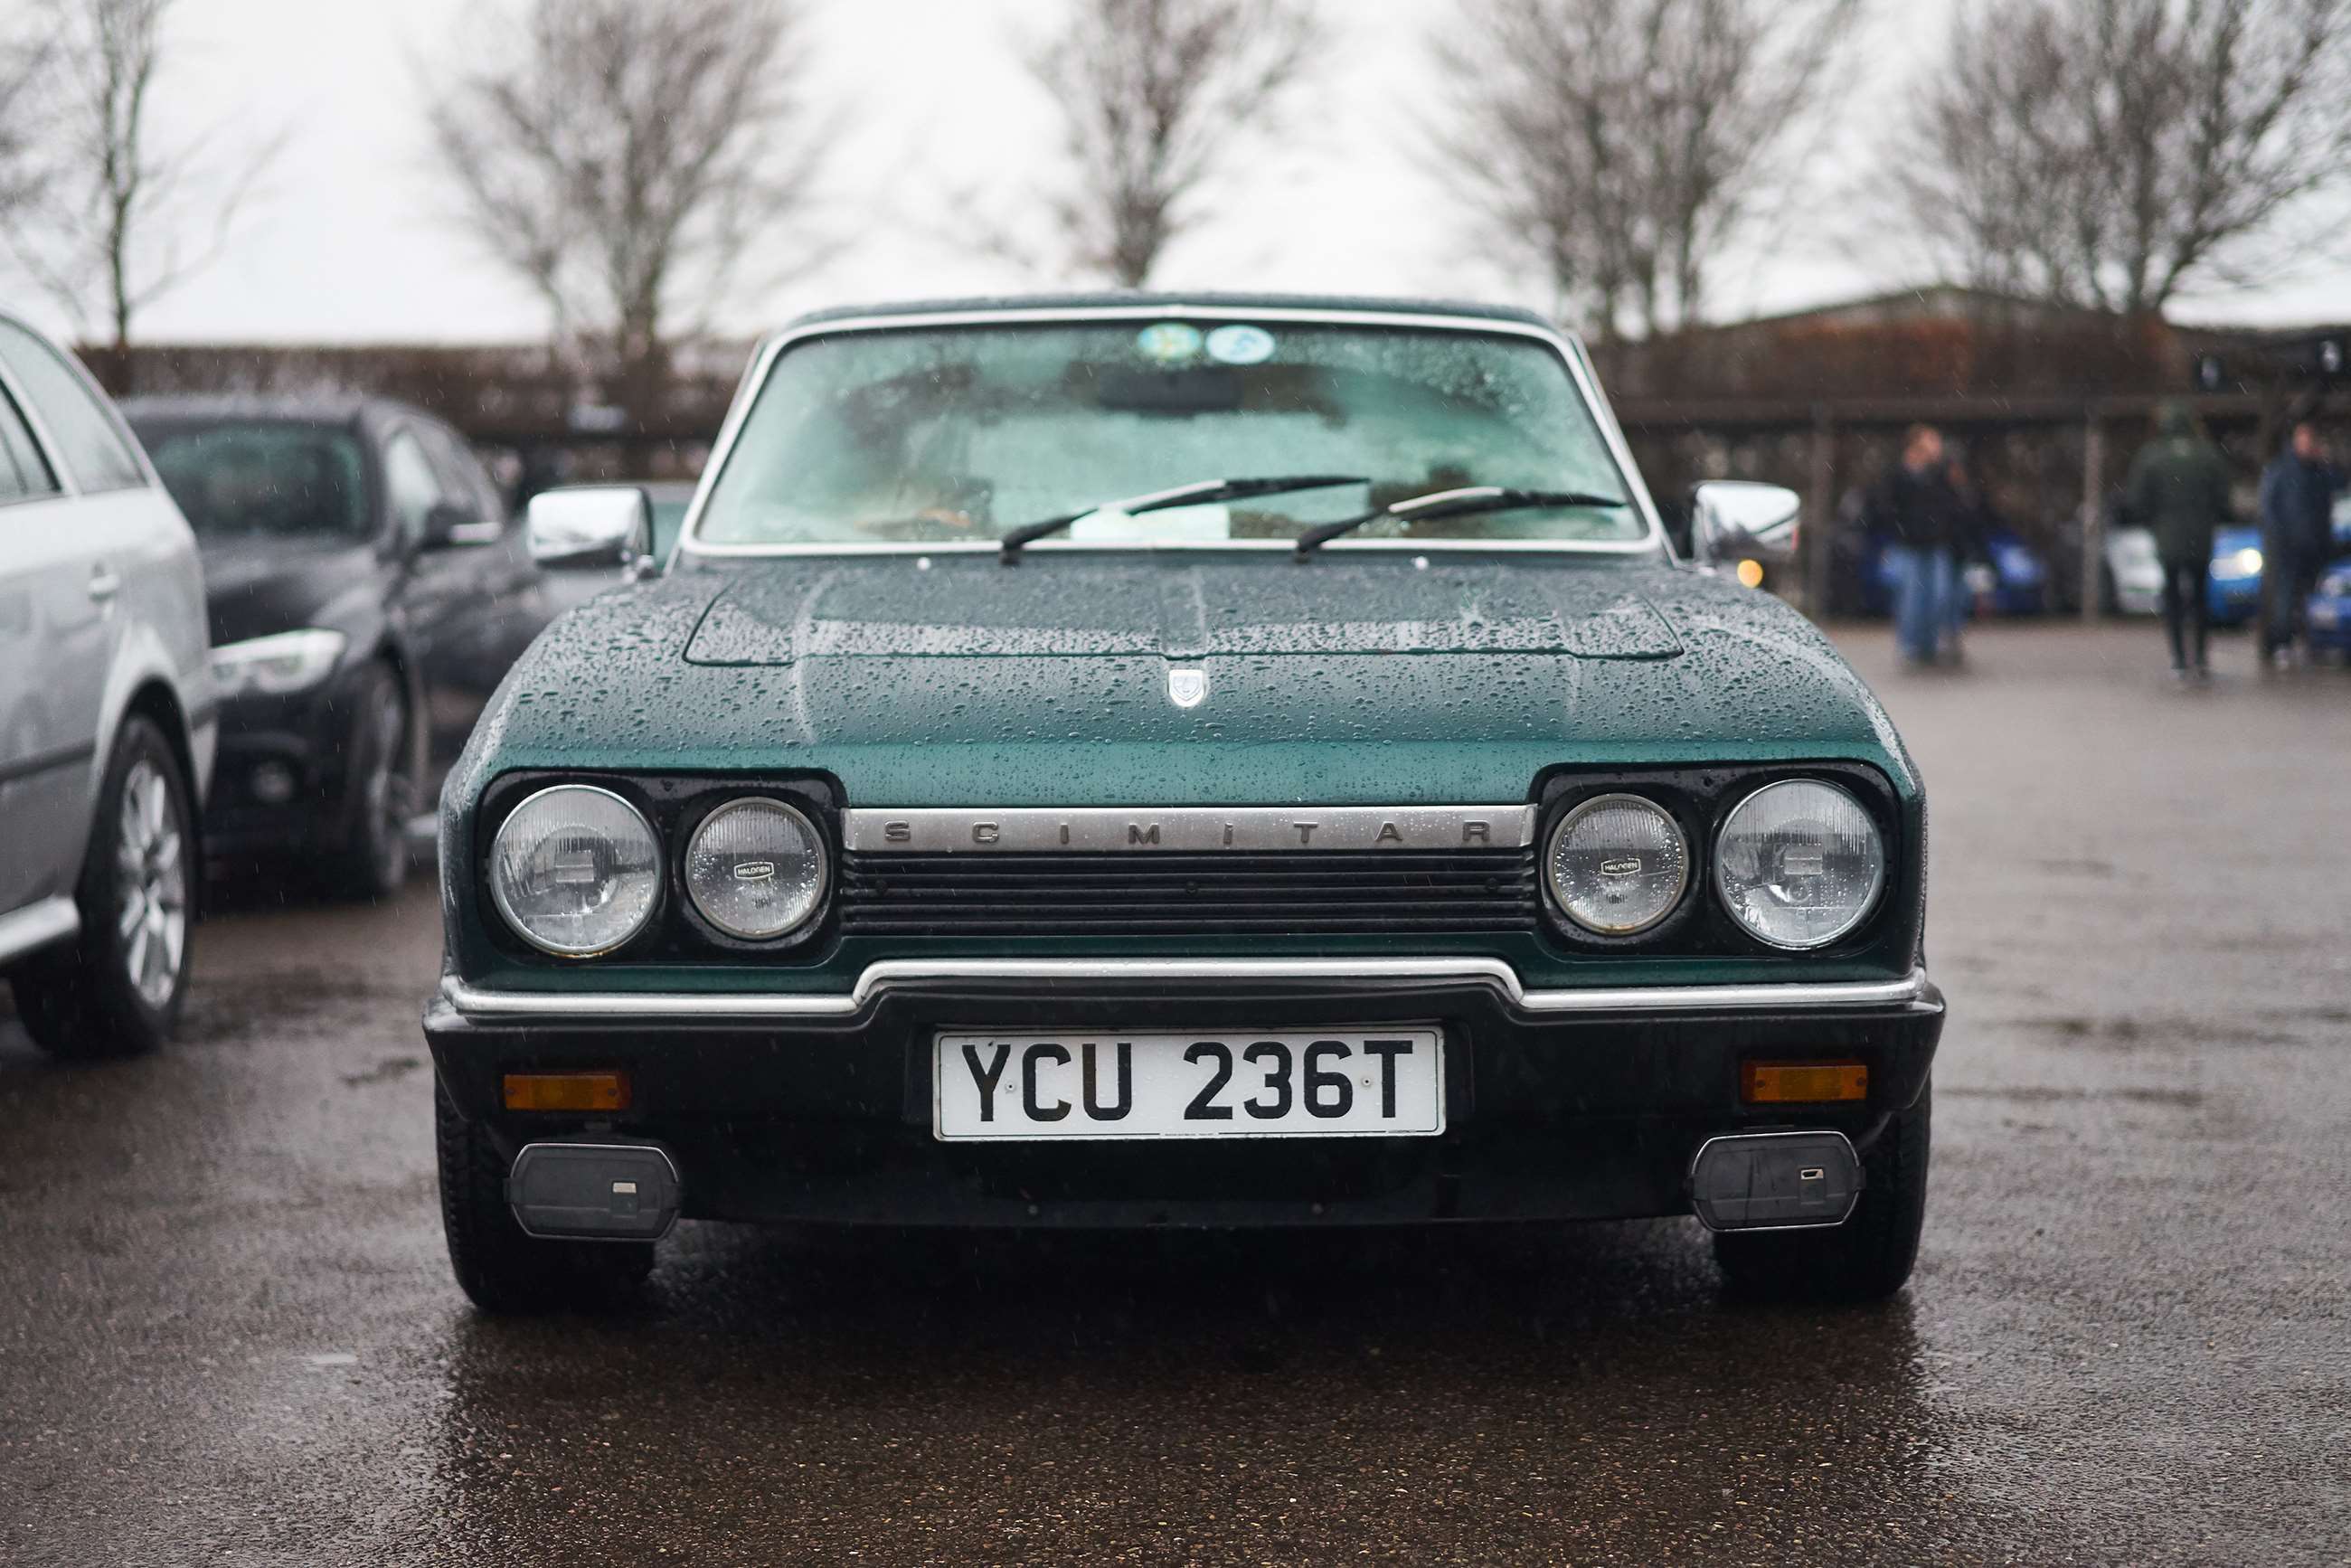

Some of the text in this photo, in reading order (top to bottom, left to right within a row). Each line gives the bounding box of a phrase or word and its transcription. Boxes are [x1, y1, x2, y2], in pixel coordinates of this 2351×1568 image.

[884, 819, 1491, 844] SCIMITAR
[737, 865, 770, 876] HALOGEN
[1604, 862, 1638, 871] HALOGEN
[961, 1040, 1413, 1122] YCU 236T
